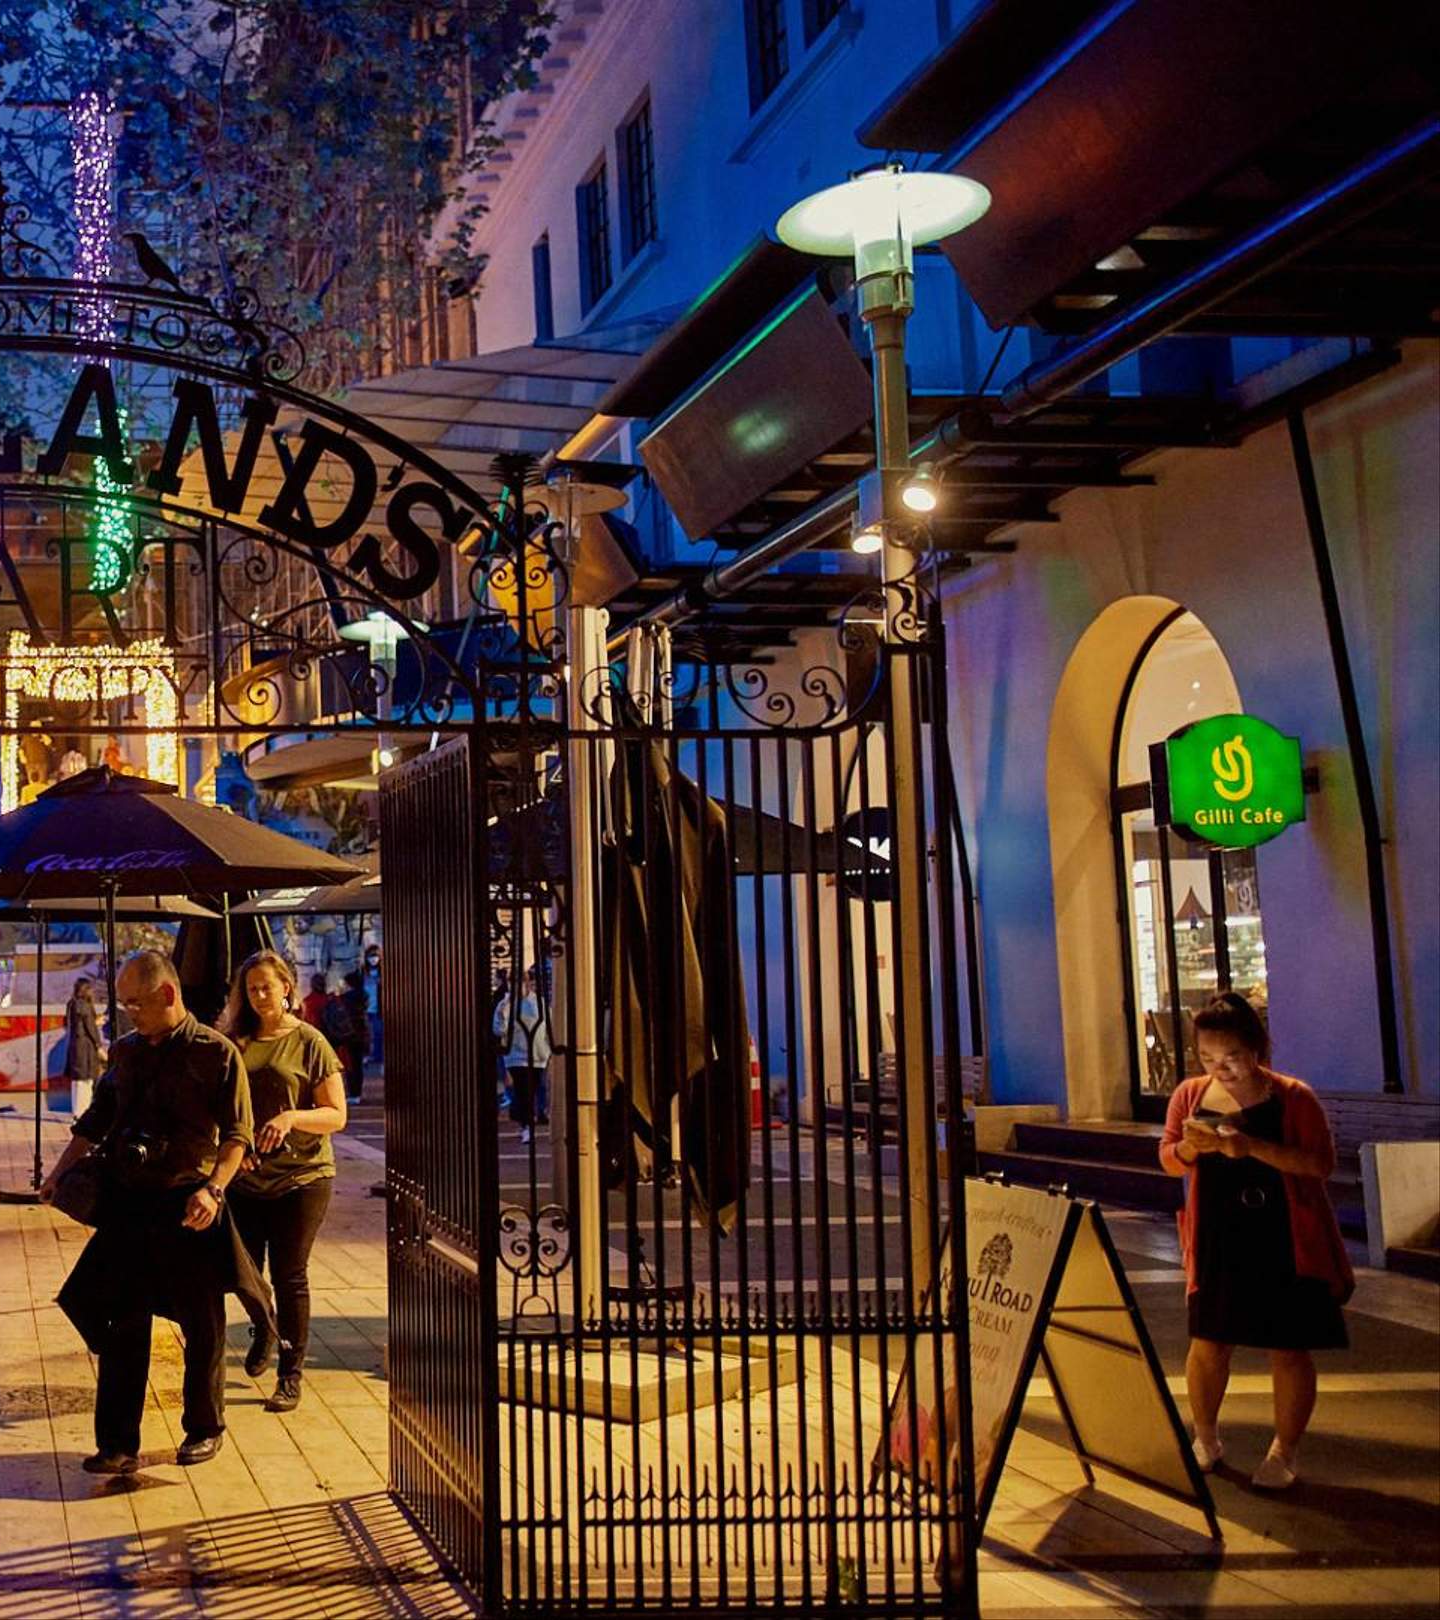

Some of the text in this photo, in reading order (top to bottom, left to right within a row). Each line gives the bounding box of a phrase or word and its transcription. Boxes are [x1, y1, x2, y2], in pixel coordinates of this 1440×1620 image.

[113, 302, 191, 349] TO
[48, 664, 209, 721] CITY
[1194, 807, 1284, 826] Gilli Cafe
[990, 1281, 1033, 1313] ROAD
